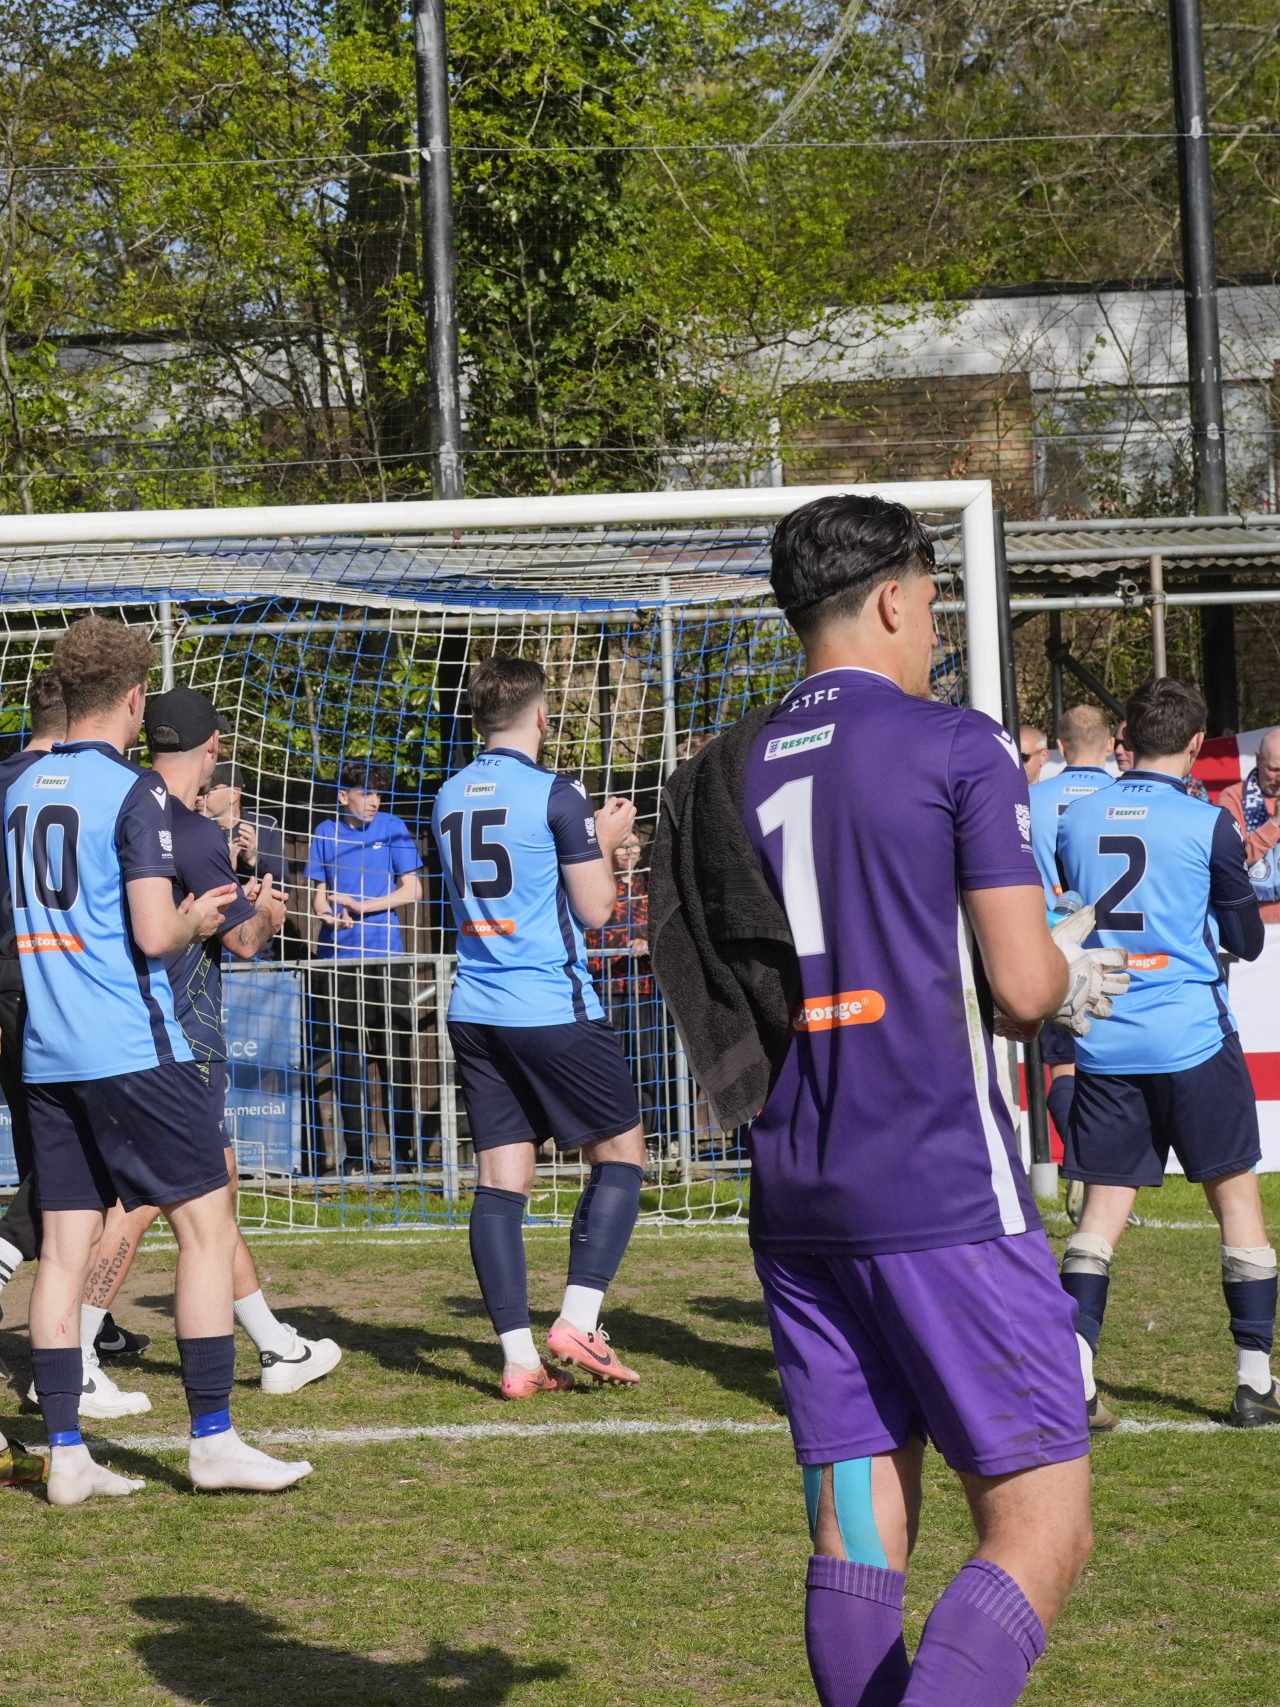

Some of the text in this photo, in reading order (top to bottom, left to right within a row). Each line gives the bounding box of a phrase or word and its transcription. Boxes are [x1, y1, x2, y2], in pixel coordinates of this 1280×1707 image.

[789, 687, 840, 712] FTFC
[781, 730, 831, 750] RESPECT
[471, 785, 495, 793] RESPECT
[1122, 785, 1153, 793] FTFC
[7, 804, 80, 912] 10
[439, 807, 515, 901] 15
[756, 775, 826, 957] 1
[1093, 834, 1148, 933] 2
